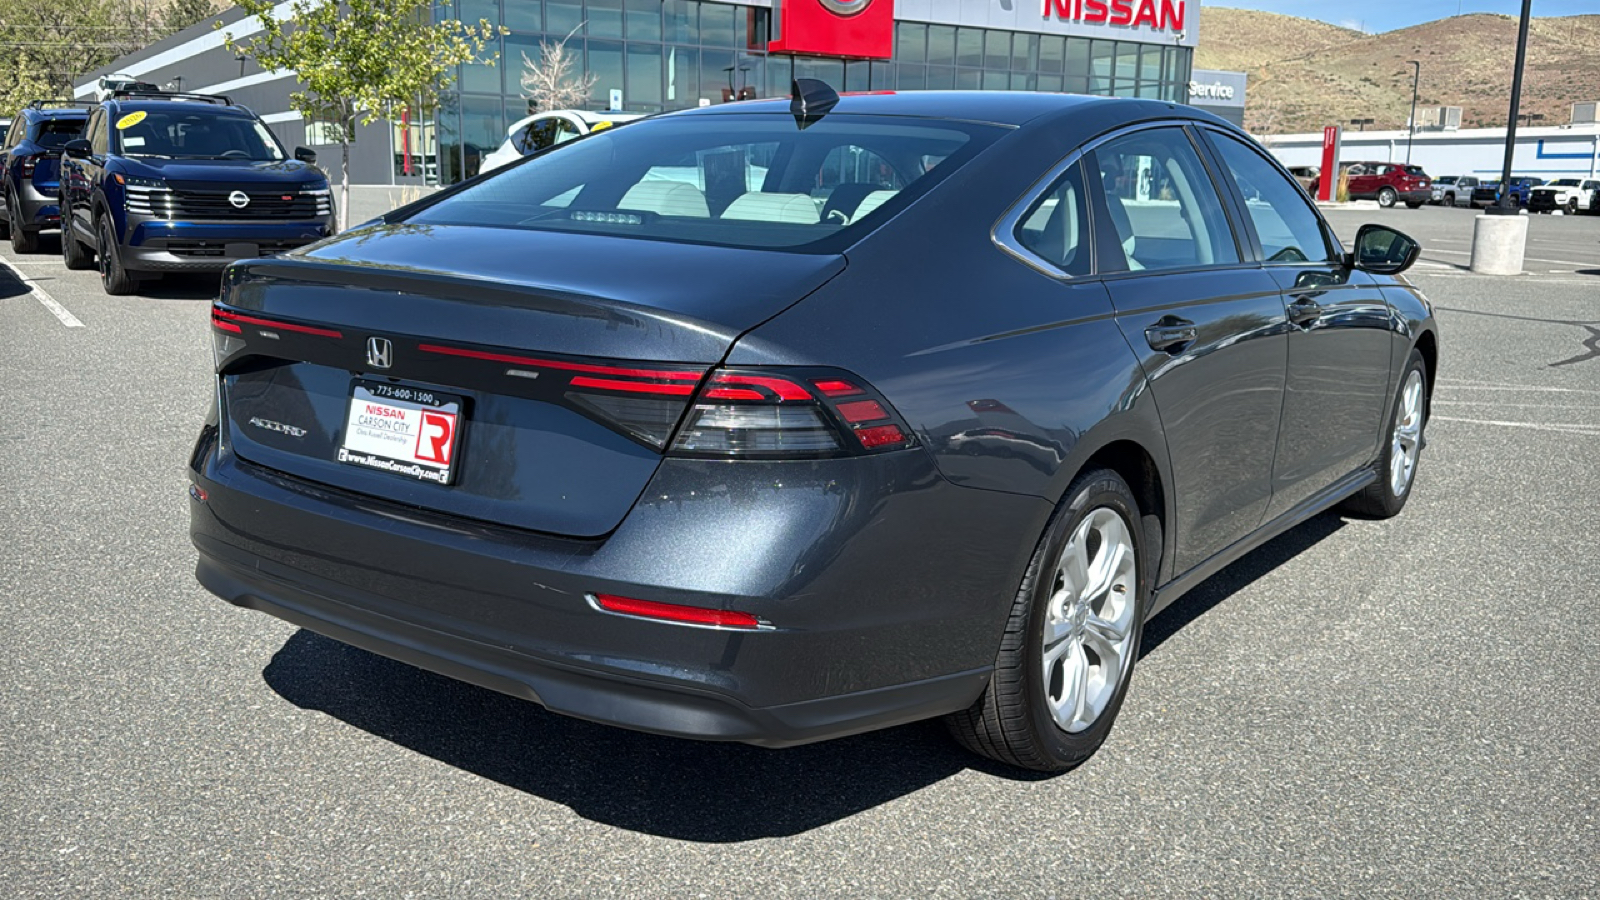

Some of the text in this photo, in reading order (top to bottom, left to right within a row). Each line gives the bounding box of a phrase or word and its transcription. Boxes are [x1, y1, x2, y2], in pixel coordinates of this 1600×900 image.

[1042, 0, 1185, 31] NISSAN
[1189, 80, 1234, 98] Service
[376, 385, 433, 403] 775-600-1500
[365, 404, 406, 420] NISSAN
[248, 416, 307, 437] ACCORD
[358, 414, 411, 433] CARSON CITY
[347, 453, 440, 480] www.NissanCarsonCity.com
